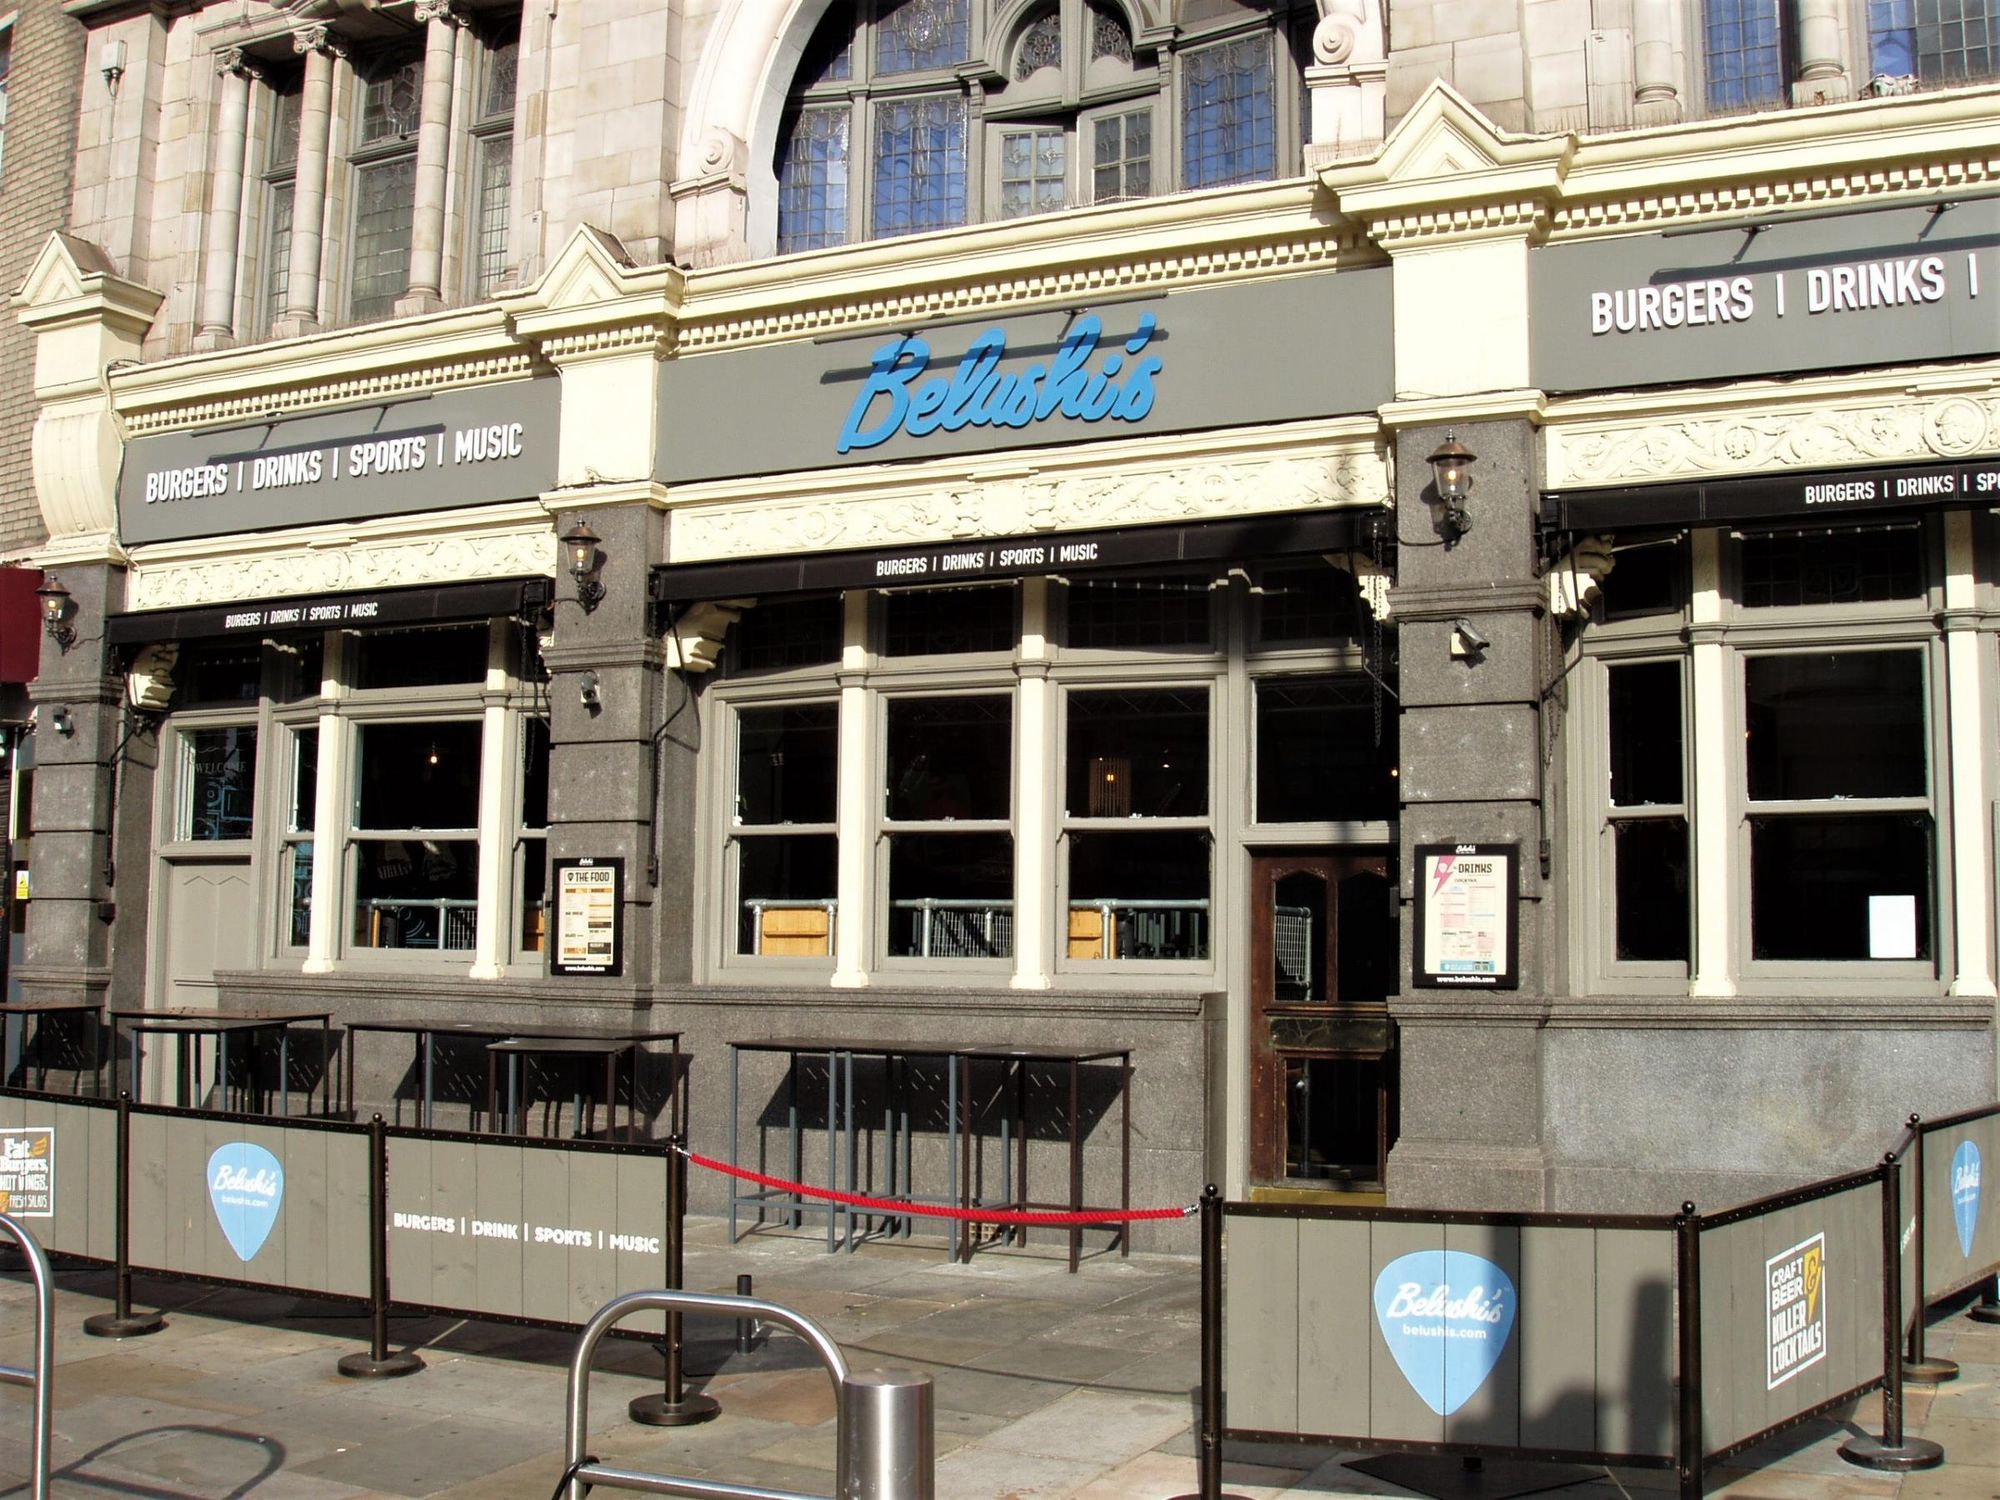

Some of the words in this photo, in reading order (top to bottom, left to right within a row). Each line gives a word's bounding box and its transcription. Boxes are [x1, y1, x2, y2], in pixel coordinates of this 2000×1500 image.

[1591, 276, 1753, 334] BURGERS
[1807, 257, 1945, 313] DRINKS
[836, 312, 1162, 453] Belushi's
[146, 463, 228, 503] BURGERS
[253, 449, 322, 490] DRINKS
[349, 436, 426, 477] SPORTS
[455, 423, 524, 463] MUSIC
[1805, 482, 1875, 504] BURGERS
[1897, 475, 1954, 497] DRINKS
[876, 557, 928, 576] BURGERS
[942, 552, 984, 571] DRINKS
[1000, 547, 1044, 566] SPORTS
[1060, 543, 1098, 562] MUSIC
[225, 612, 261, 628] BURGERS
[270, 608, 300, 624] DRINKS
[309, 605, 340, 621] SPORTS
[351, 602, 378, 617] MUSIC
[575, 872, 589, 882] THE
[591, 872, 610, 882] FOOD
[1458, 863, 1492, 873] DRINKS
[393, 1213, 455, 1233] BURGERS
[471, 1220, 518, 1240] DRINK
[534, 1226, 592, 1247] SPORTS
[609, 1234, 660, 1253] MUSIC
[1771, 1257, 1804, 1288] CRAFT
[1386, 1282, 1503, 1323] Belushi's
[1772, 1276, 1804, 1311] BEER
[1402, 1324, 1487, 1339] belushis.com
[1772, 1300, 1806, 1345] KILLER
[1772, 1320, 1821, 1374] COCKTAILS
